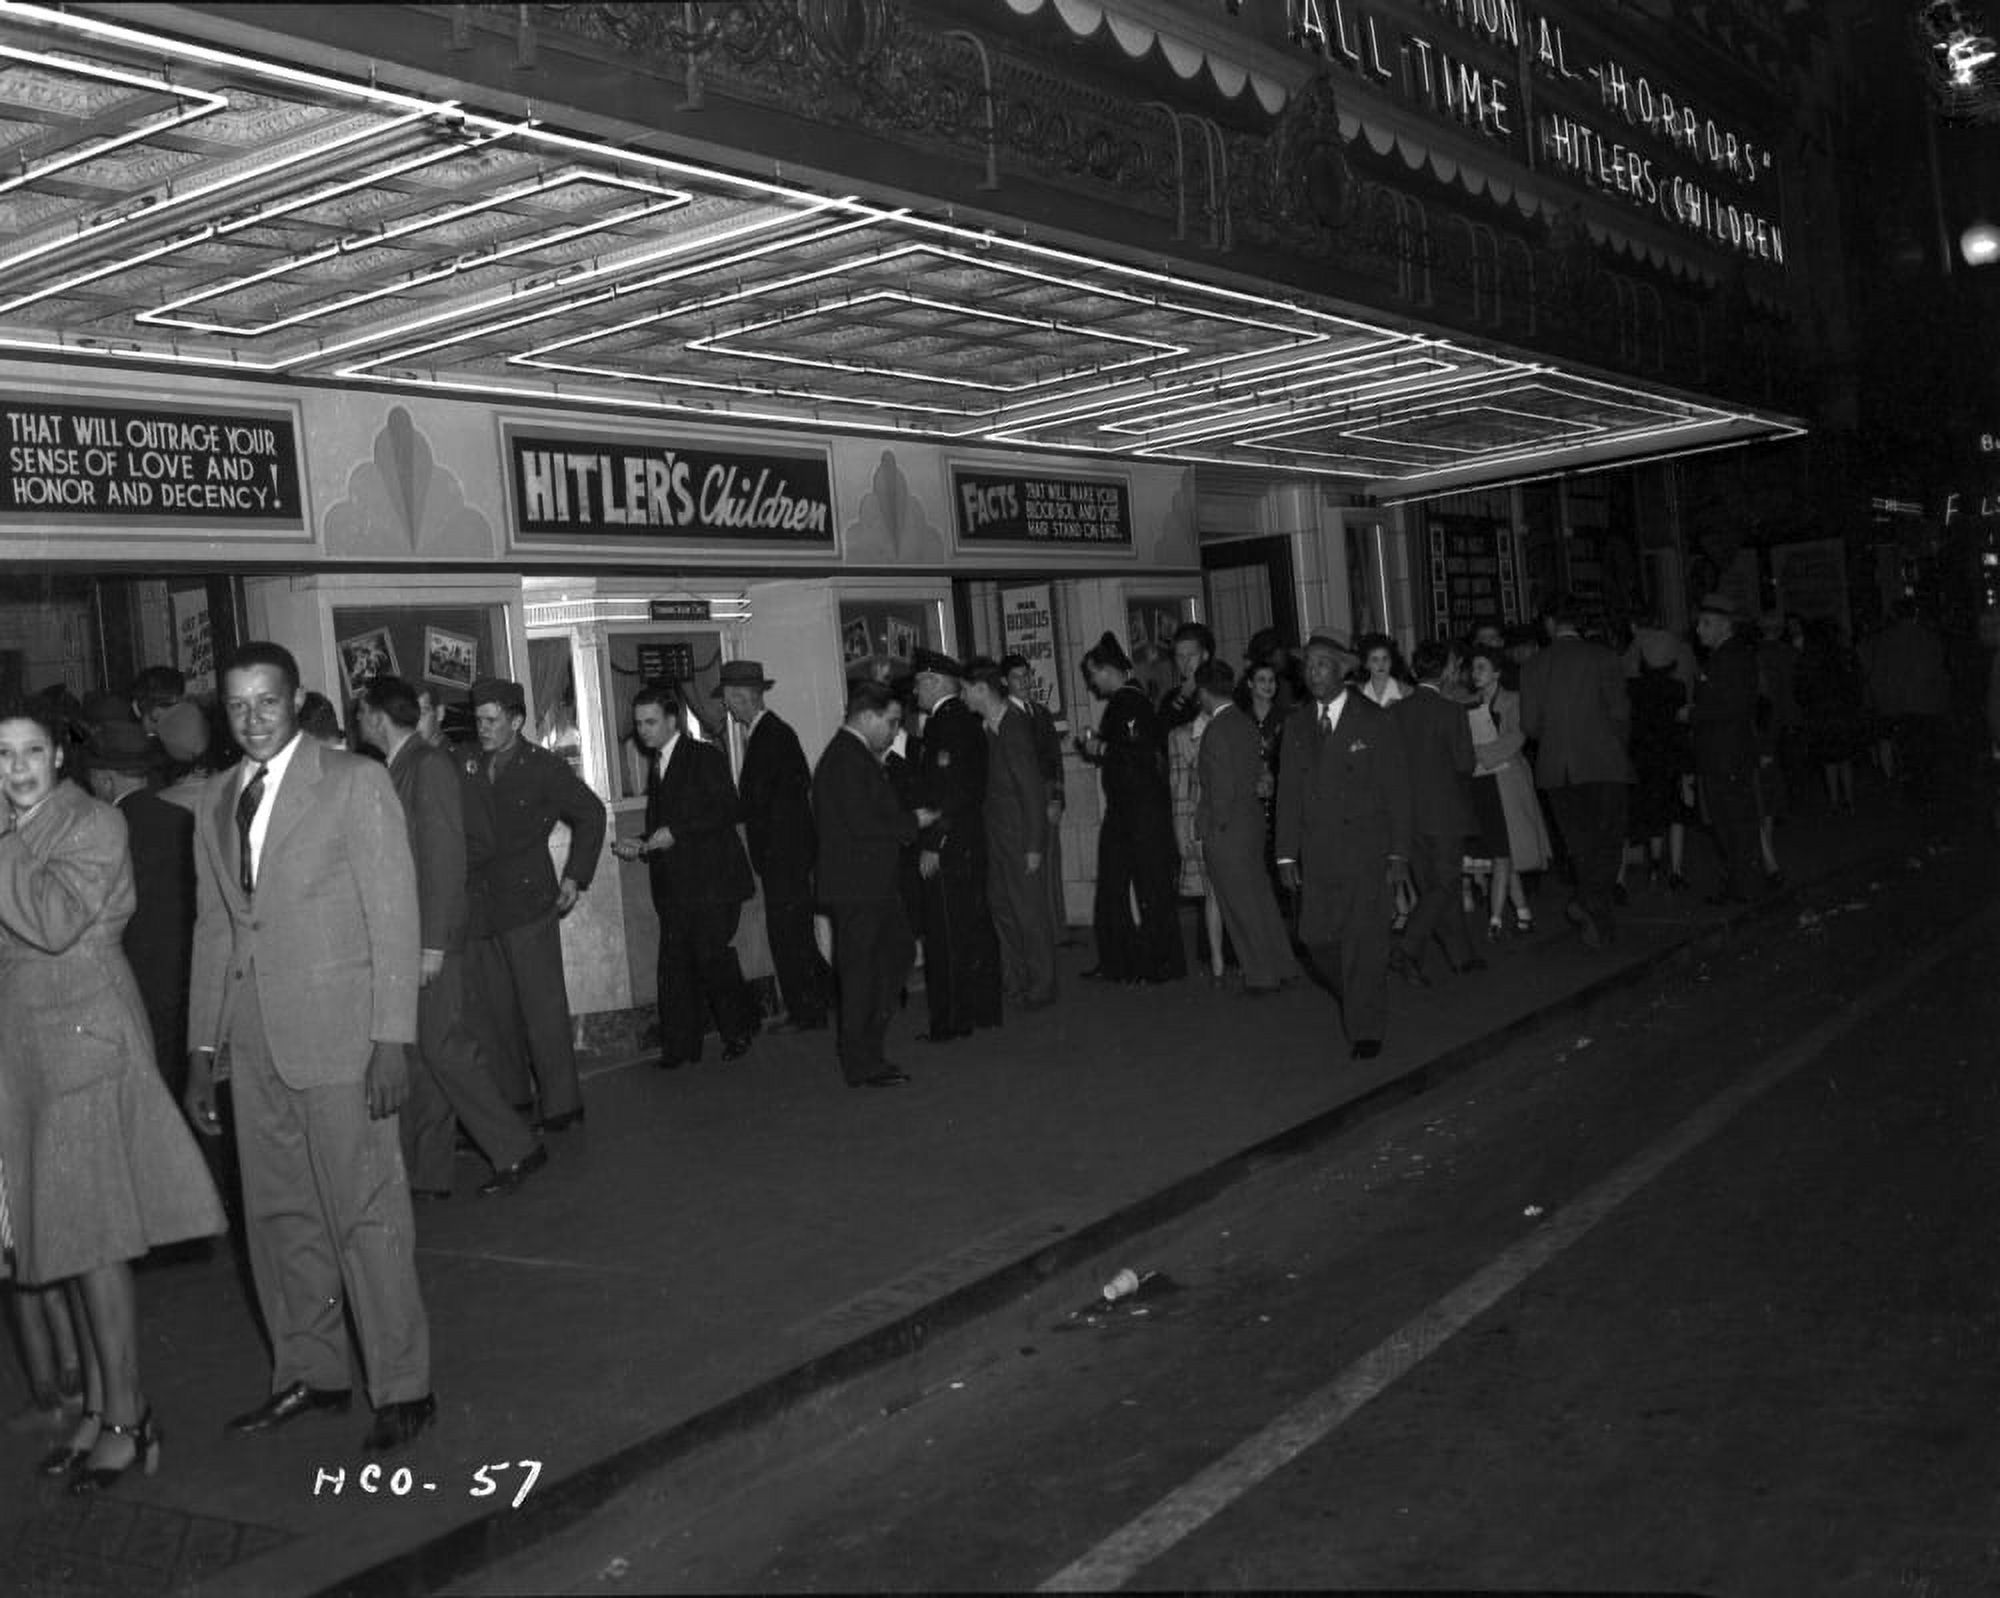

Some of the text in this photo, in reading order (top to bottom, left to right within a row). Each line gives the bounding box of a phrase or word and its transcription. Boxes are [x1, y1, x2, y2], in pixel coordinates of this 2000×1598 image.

[1404, 36, 1511, 134] TIME
[1551, 113, 1657, 205] HITLERS
[1673, 176, 1783, 264] CHILDREN
[7, 413, 278, 456] THAT WILL OUTRAGE YOUR
[10, 447, 255, 481] SENSE OF LOVE AND
[13, 477, 97, 505] HONOR
[107, 481, 153, 507] AND
[521, 450, 827, 533] HITLER'S Children
[960, 482, 1020, 533] FACTS
